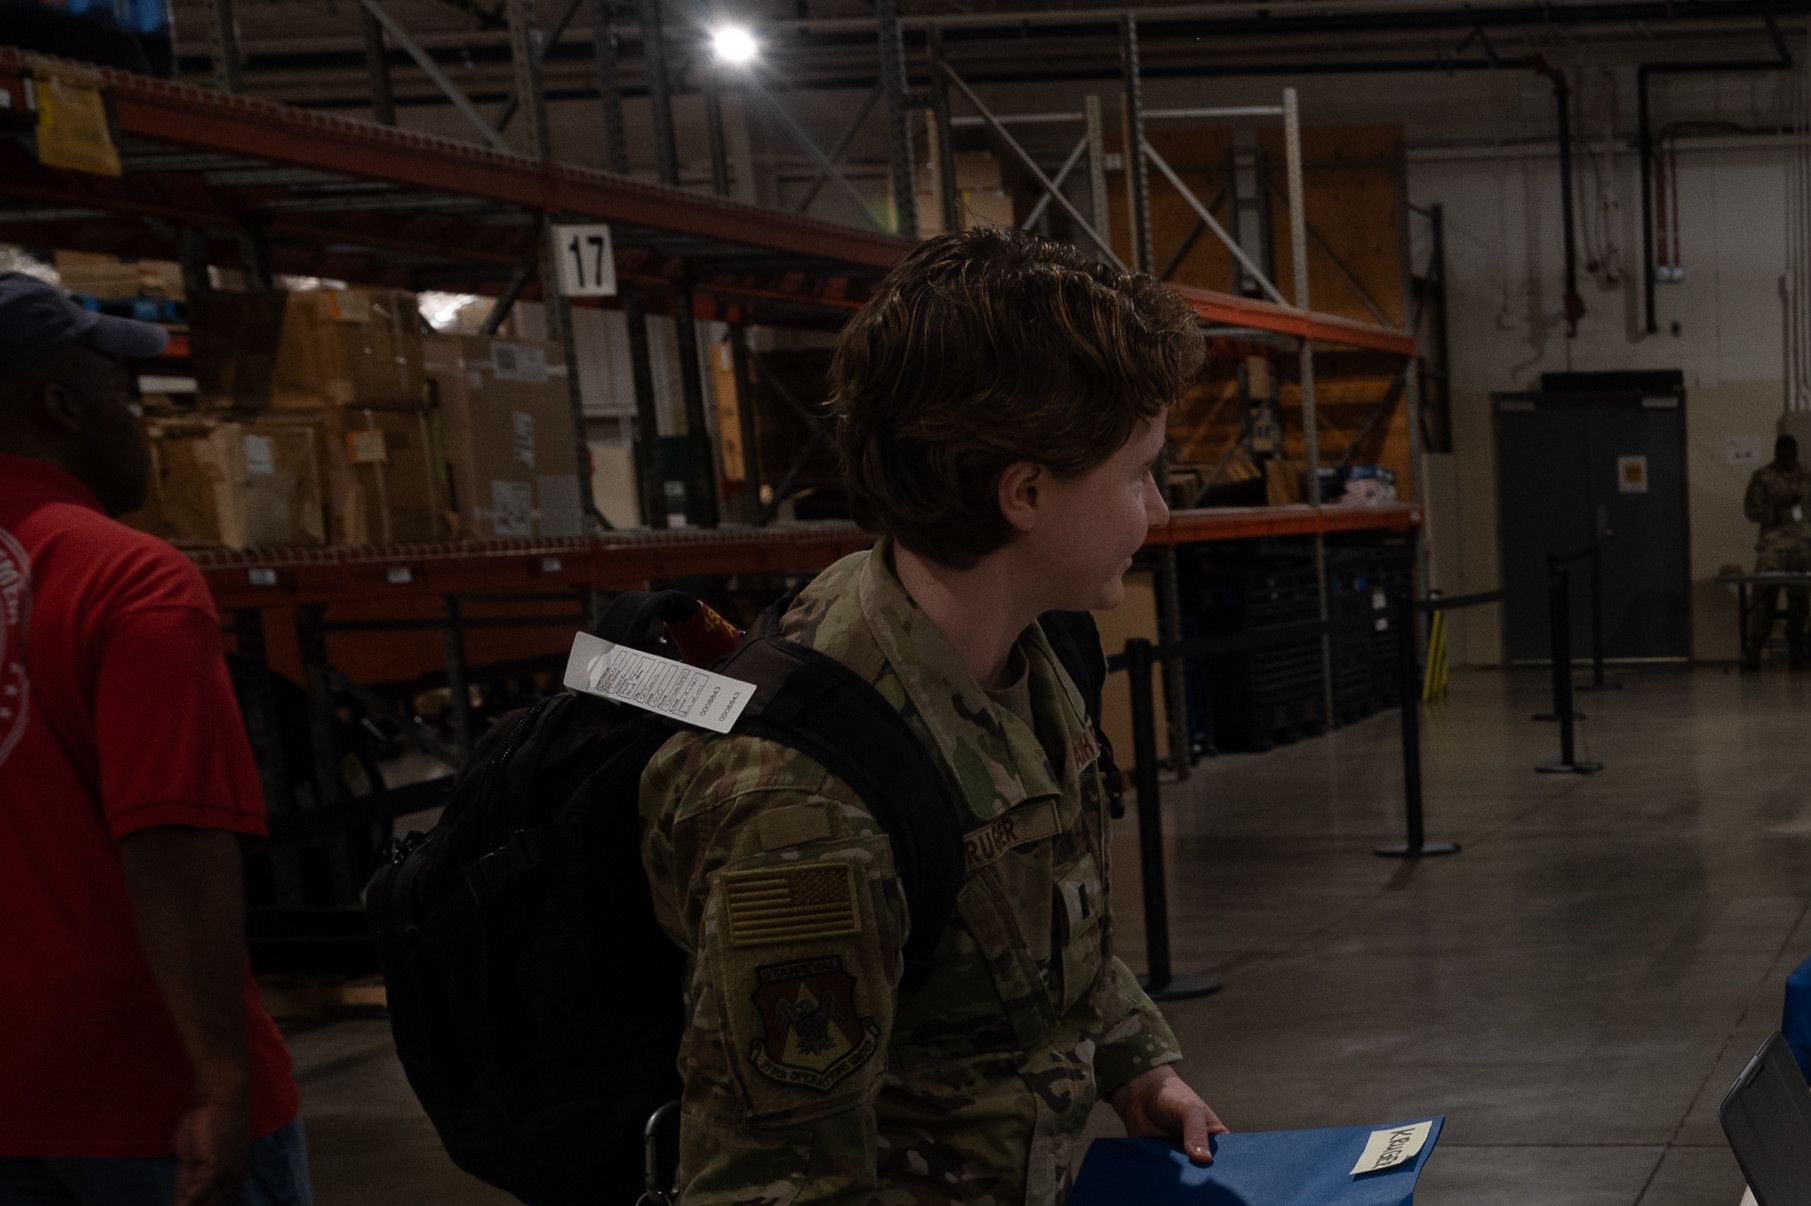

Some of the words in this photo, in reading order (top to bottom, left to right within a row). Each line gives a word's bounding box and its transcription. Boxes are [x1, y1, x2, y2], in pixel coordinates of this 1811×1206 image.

[567, 235, 606, 288] 17
[964, 816, 1018, 866] RUGER
[790, 1063, 851, 1087] OPERATIONS
[1371, 1126, 1416, 1170] KRUGER
